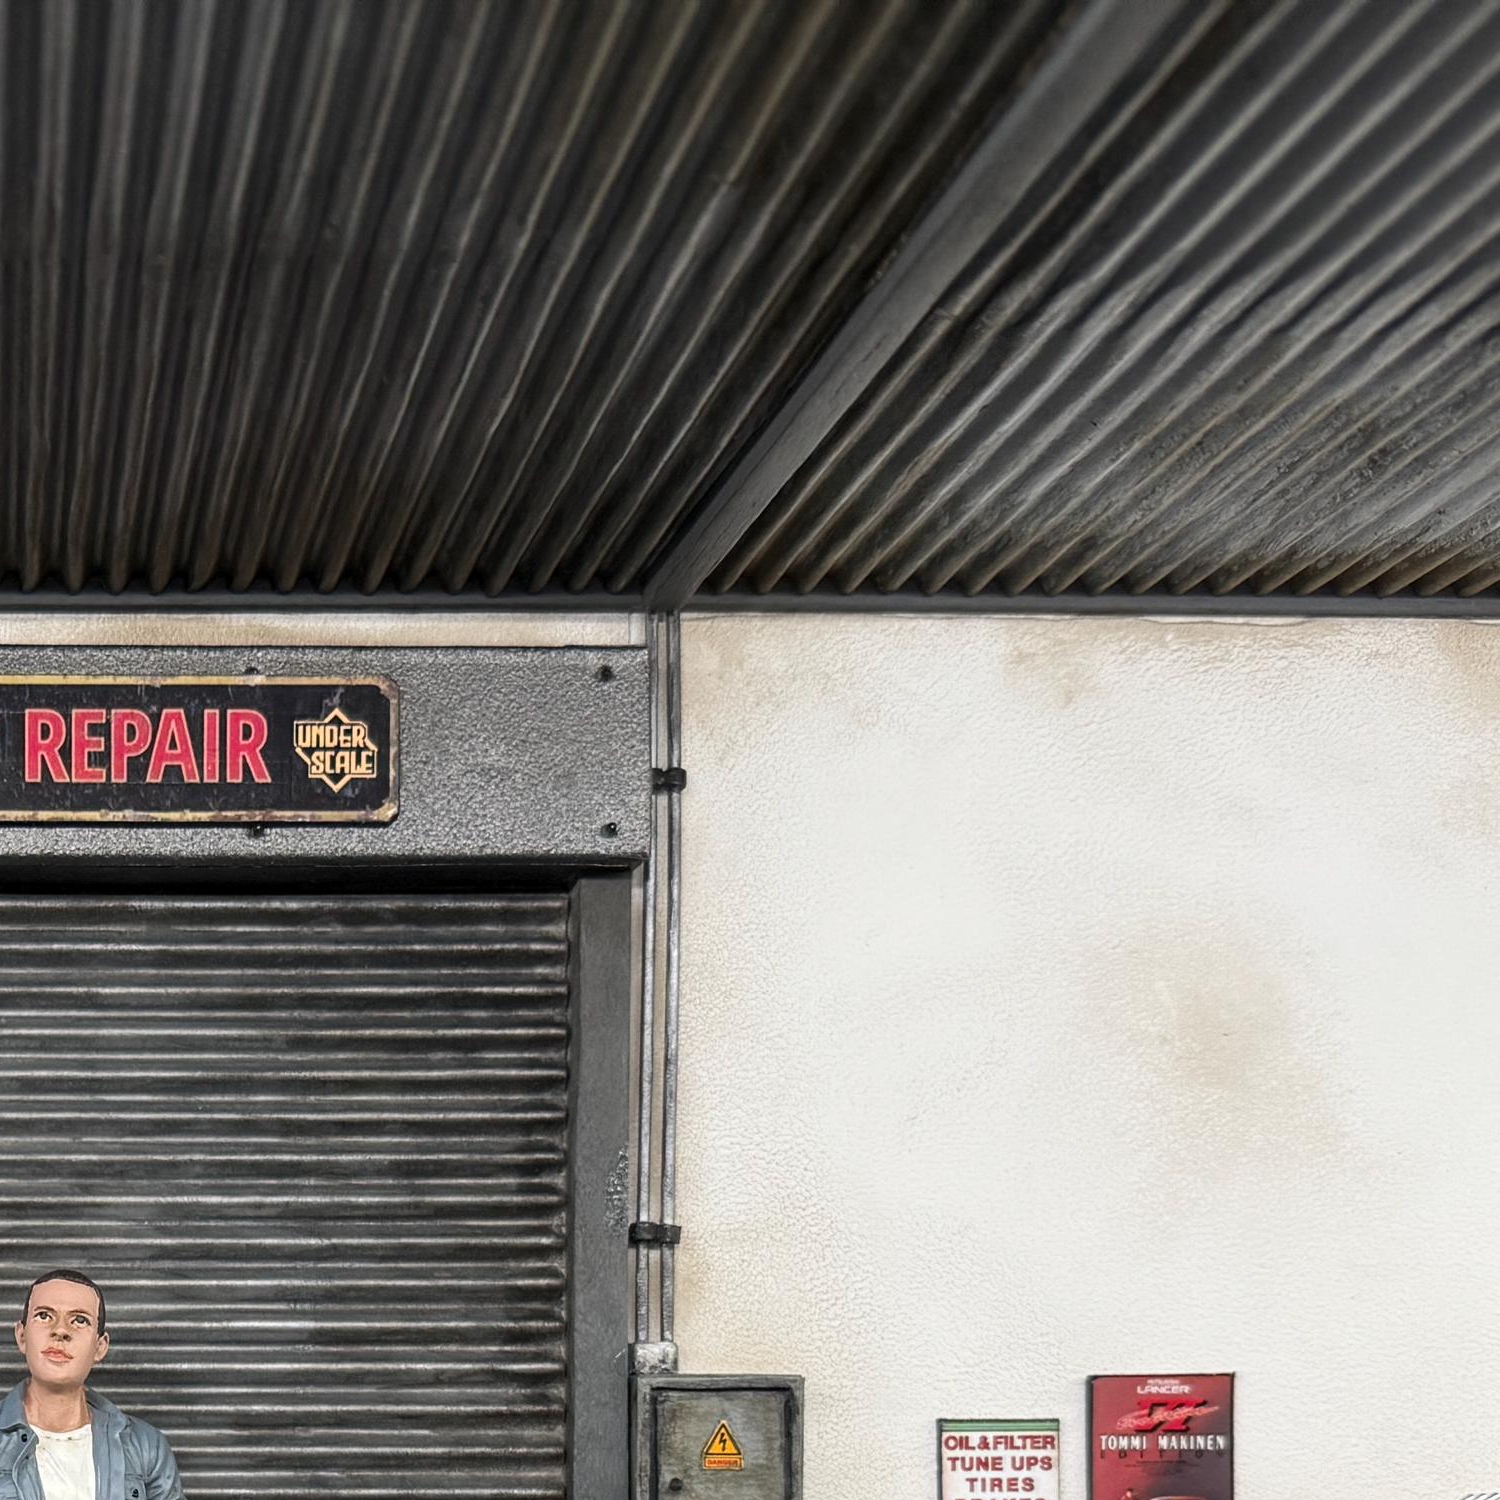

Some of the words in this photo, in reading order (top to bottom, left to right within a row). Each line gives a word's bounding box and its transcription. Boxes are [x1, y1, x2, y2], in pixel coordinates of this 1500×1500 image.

[297, 724, 367, 748] UNDER
[24, 707, 272, 783] REPAIR
[310, 750, 374, 775] SCALE
[1136, 1384, 1192, 1394] LANCER
[1100, 1434, 1147, 1450] TOMMI
[1158, 1434, 1226, 1450] MAKINEN
[947, 1456, 1004, 1472] TUNE
[1011, 1455, 1053, 1471] UPS
[965, 1477, 1035, 1493] TIRES
